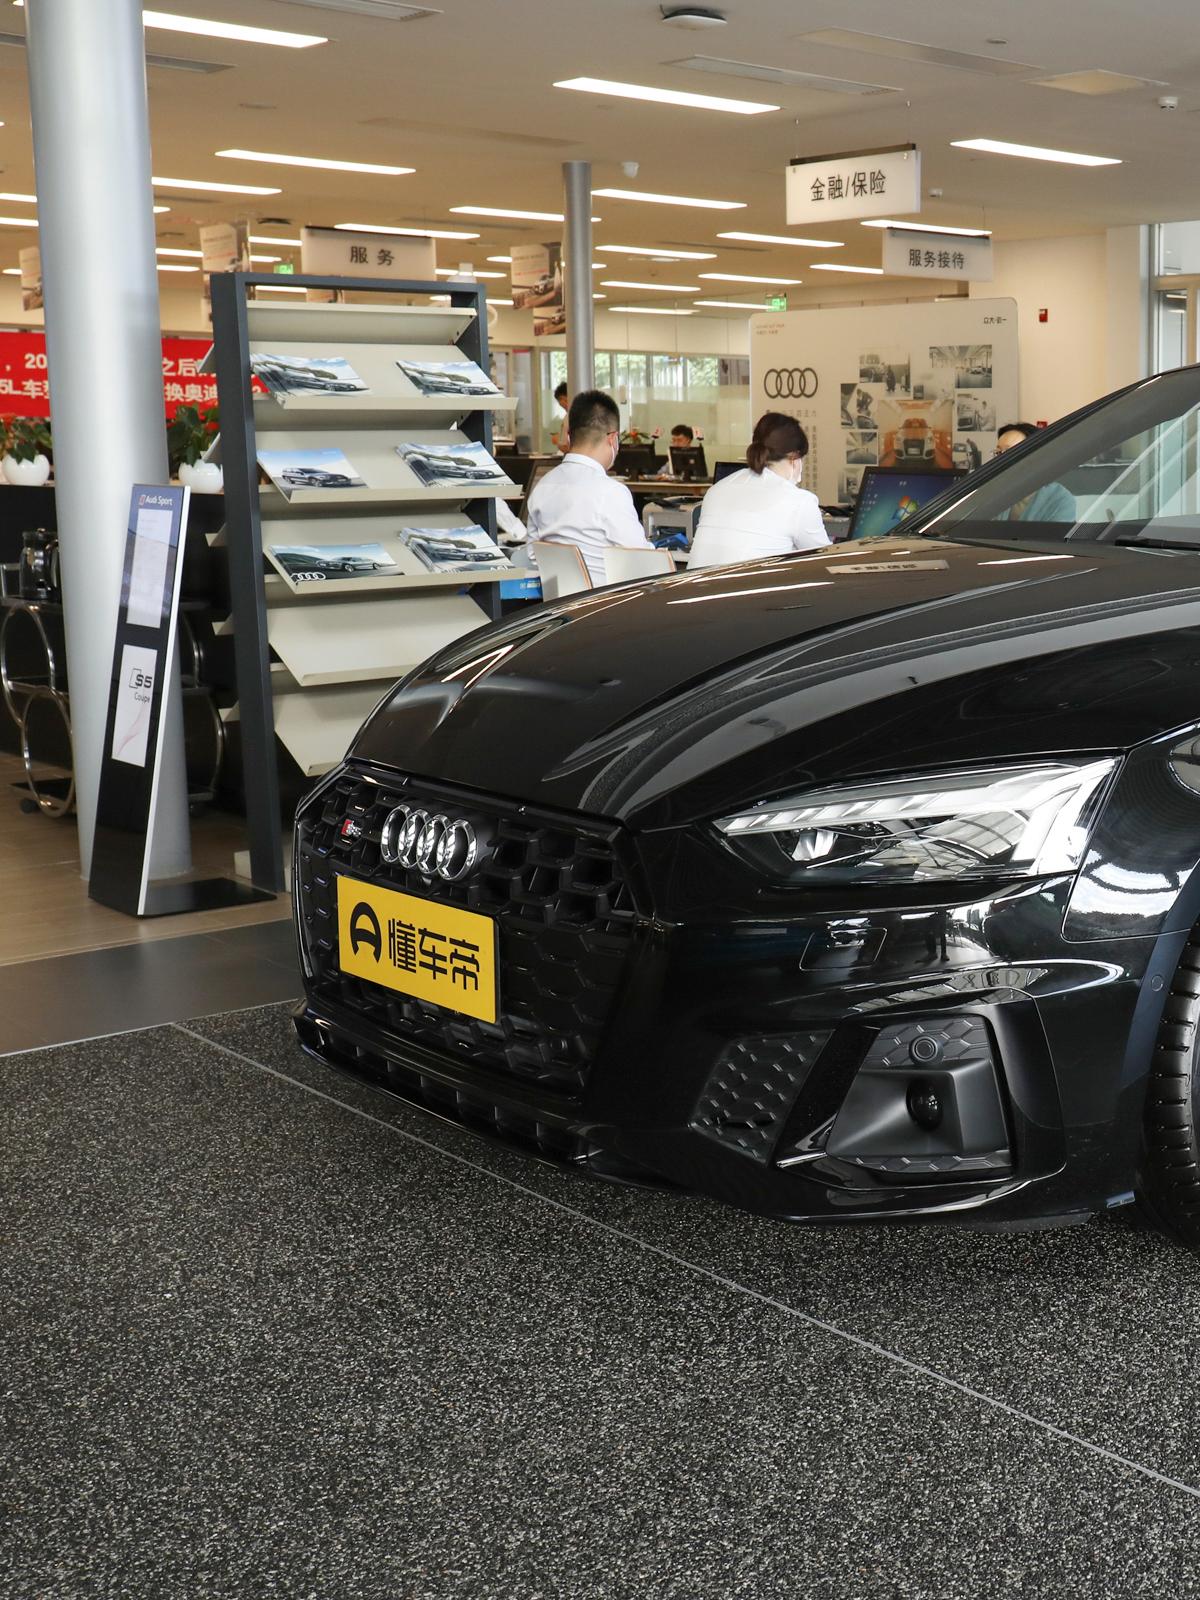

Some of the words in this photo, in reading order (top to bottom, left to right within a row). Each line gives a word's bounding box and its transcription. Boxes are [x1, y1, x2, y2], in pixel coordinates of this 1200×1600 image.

[810, 169, 887, 202] 金融/保险
[349, 245, 395, 266] 服务
[908, 248, 965, 270] 服务接待
[145, 496, 157, 504] Audi
[157, 496, 173, 506] Sport
[135, 674, 152, 688] S5
[388, 918, 480, 991] 懂车帝
